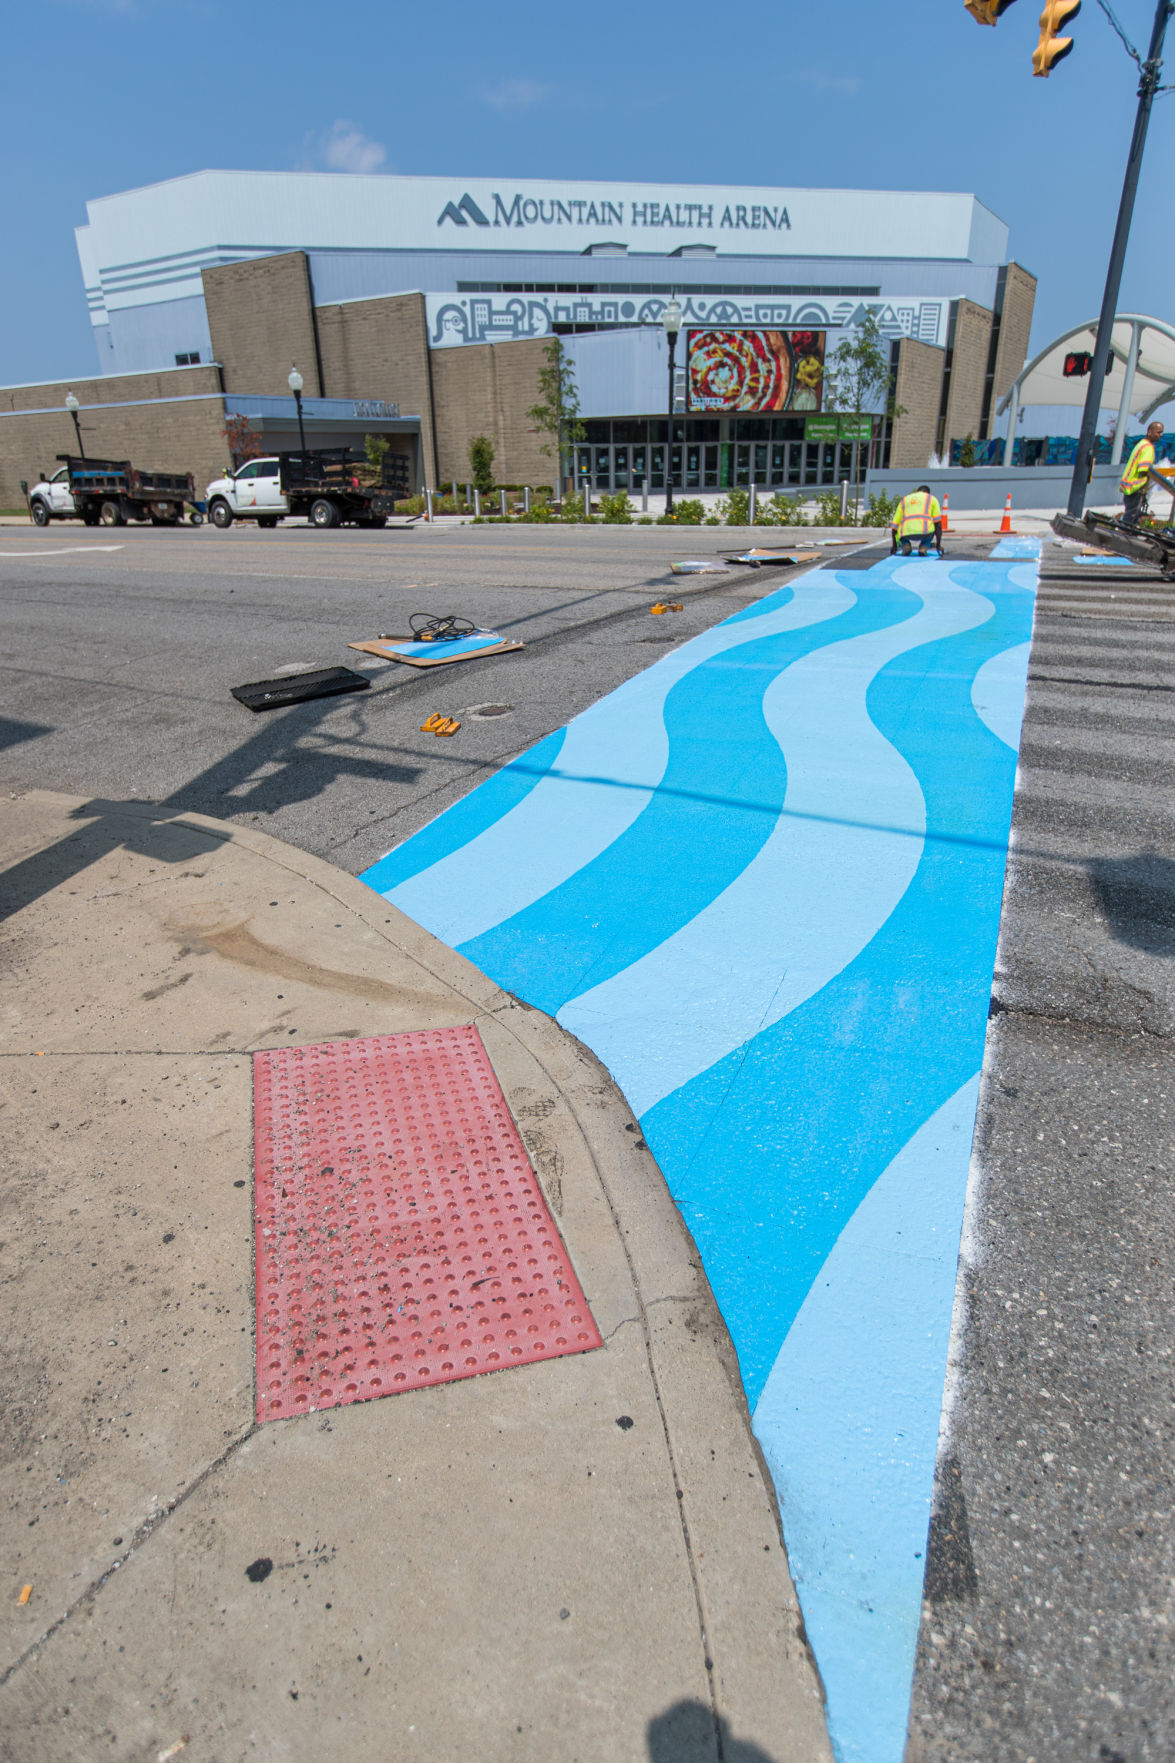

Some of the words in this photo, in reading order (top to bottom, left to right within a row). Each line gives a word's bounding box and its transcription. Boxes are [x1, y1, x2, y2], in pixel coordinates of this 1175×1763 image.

[492, 192, 624, 228] MOUNTAIN
[631, 202, 714, 228] HEALTH
[719, 205, 792, 230] ARENA
